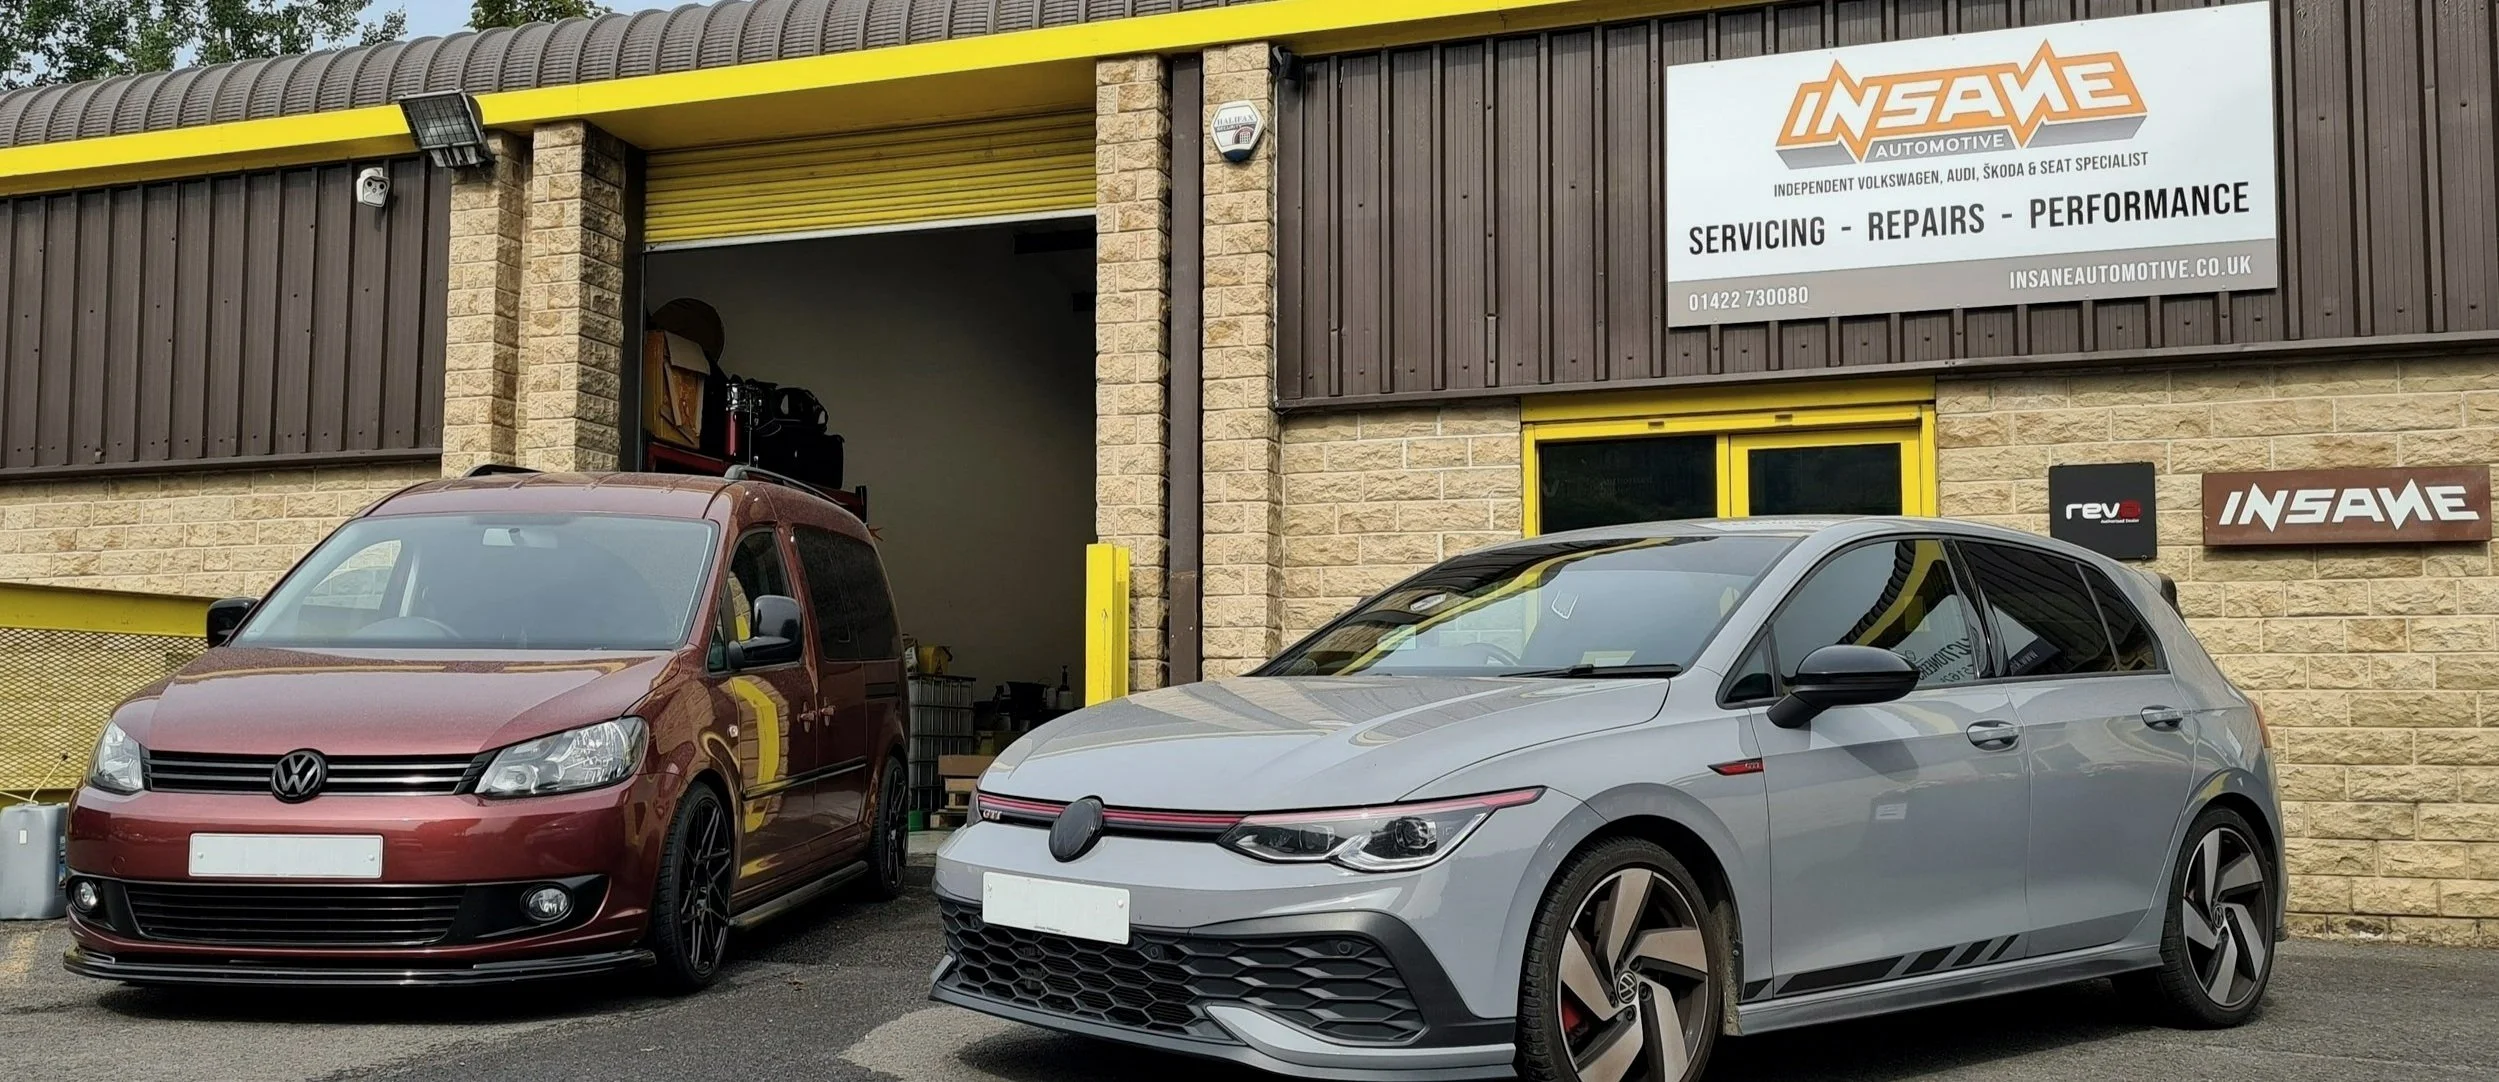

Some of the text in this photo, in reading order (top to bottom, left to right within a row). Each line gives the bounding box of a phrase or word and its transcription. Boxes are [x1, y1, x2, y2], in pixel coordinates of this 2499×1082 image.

[1789, 55, 2133, 142] INSANE
[1875, 133, 2005, 158] AUTOMOTIVE
[1774, 152, 2148, 197] INDEPENDENT VOLKSWAGEN, AUDI, ŠKODA & SEAT SPECIALIST
[1689, 216, 1825, 255] SERVICING
[1868, 203, 1985, 241] REPAIRS
[2030, 181, 2249, 229] PERFORMANCE
[2009, 255, 2251, 290] INSANEAUTOMOTIVE.CO.UK
[1689, 286, 1809, 312] 01422 730080
[2219, 477, 2480, 533] INSANE
[982, 808, 1002, 820] GTI
